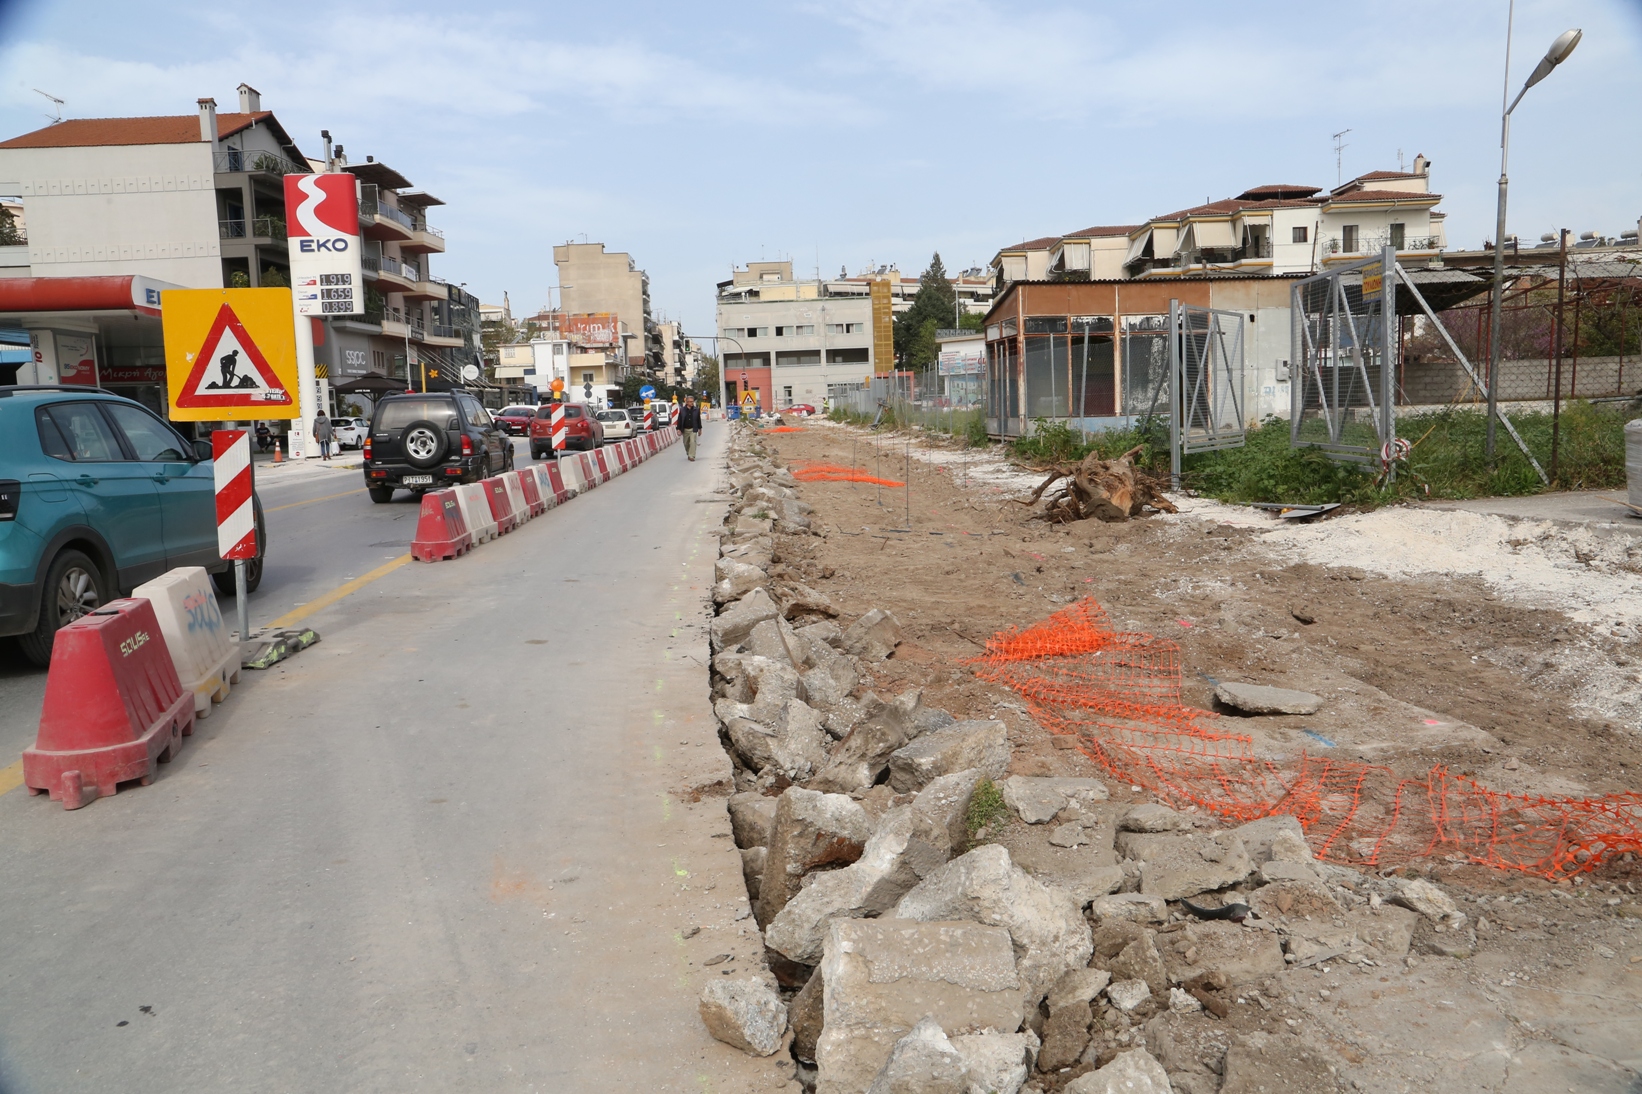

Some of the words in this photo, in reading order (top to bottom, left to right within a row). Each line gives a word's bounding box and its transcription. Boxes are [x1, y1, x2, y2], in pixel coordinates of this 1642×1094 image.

[300, 238, 348, 253] EKO
[321, 275, 351, 286] 1.919
[322, 289, 353, 300] 1.659
[323, 302, 354, 313] 0.899
